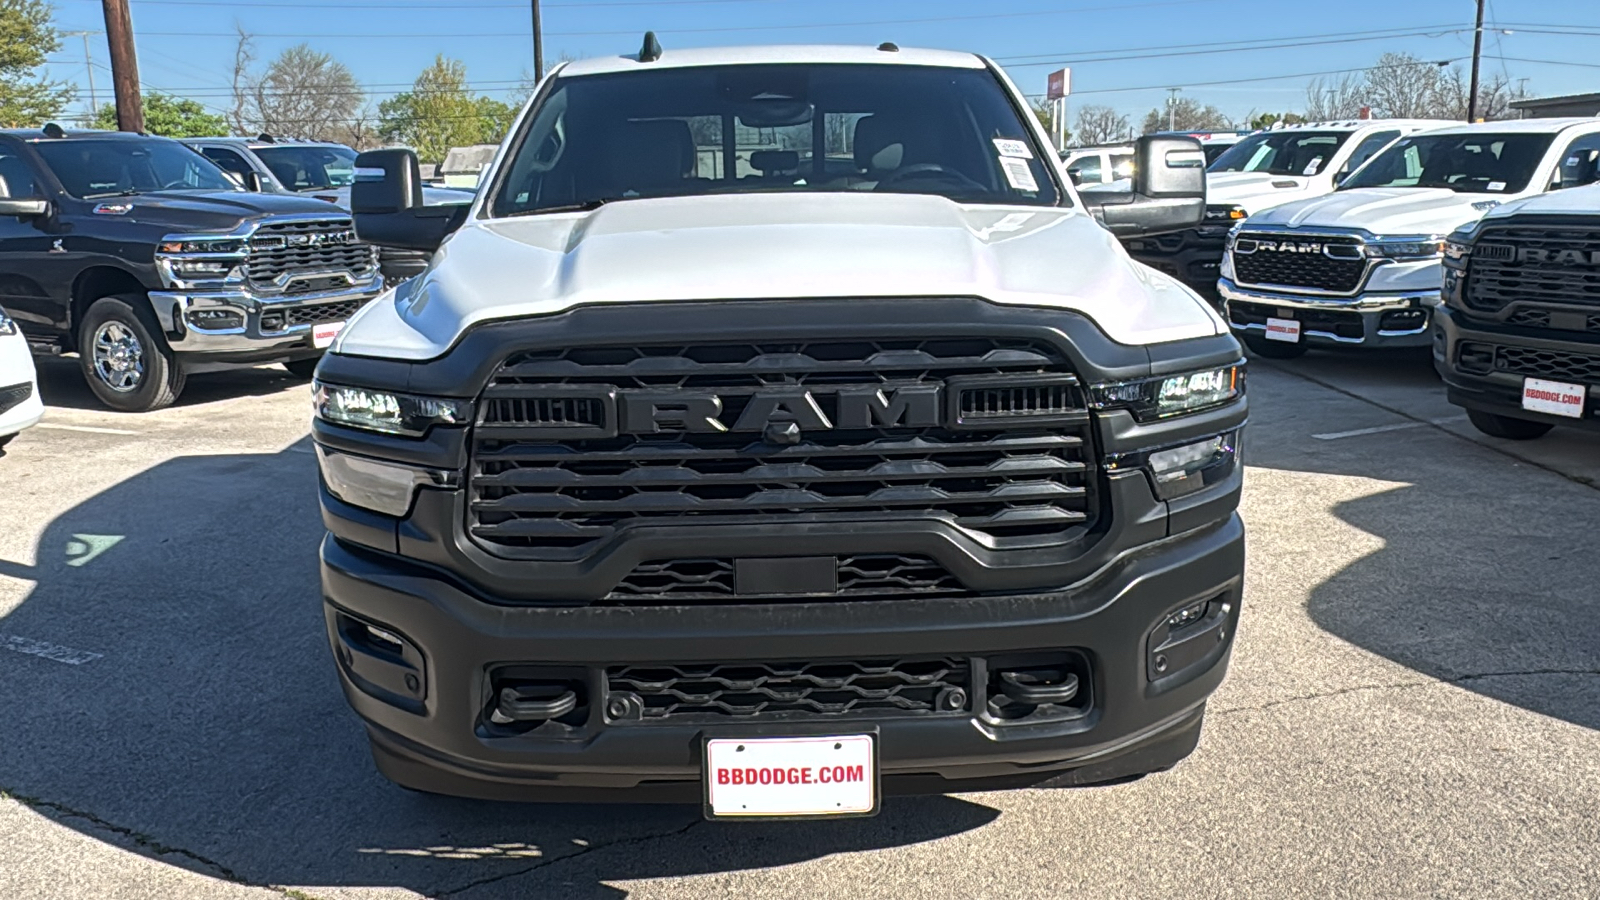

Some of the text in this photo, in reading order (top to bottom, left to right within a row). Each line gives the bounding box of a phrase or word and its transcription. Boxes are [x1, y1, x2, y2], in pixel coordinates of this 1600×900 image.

[1259, 241, 1321, 254] RAM
[1525, 388, 1582, 405] BBDODGE.COM
[619, 388, 942, 431] RAM
[717, 765, 864, 785] BBDODGE.COM
